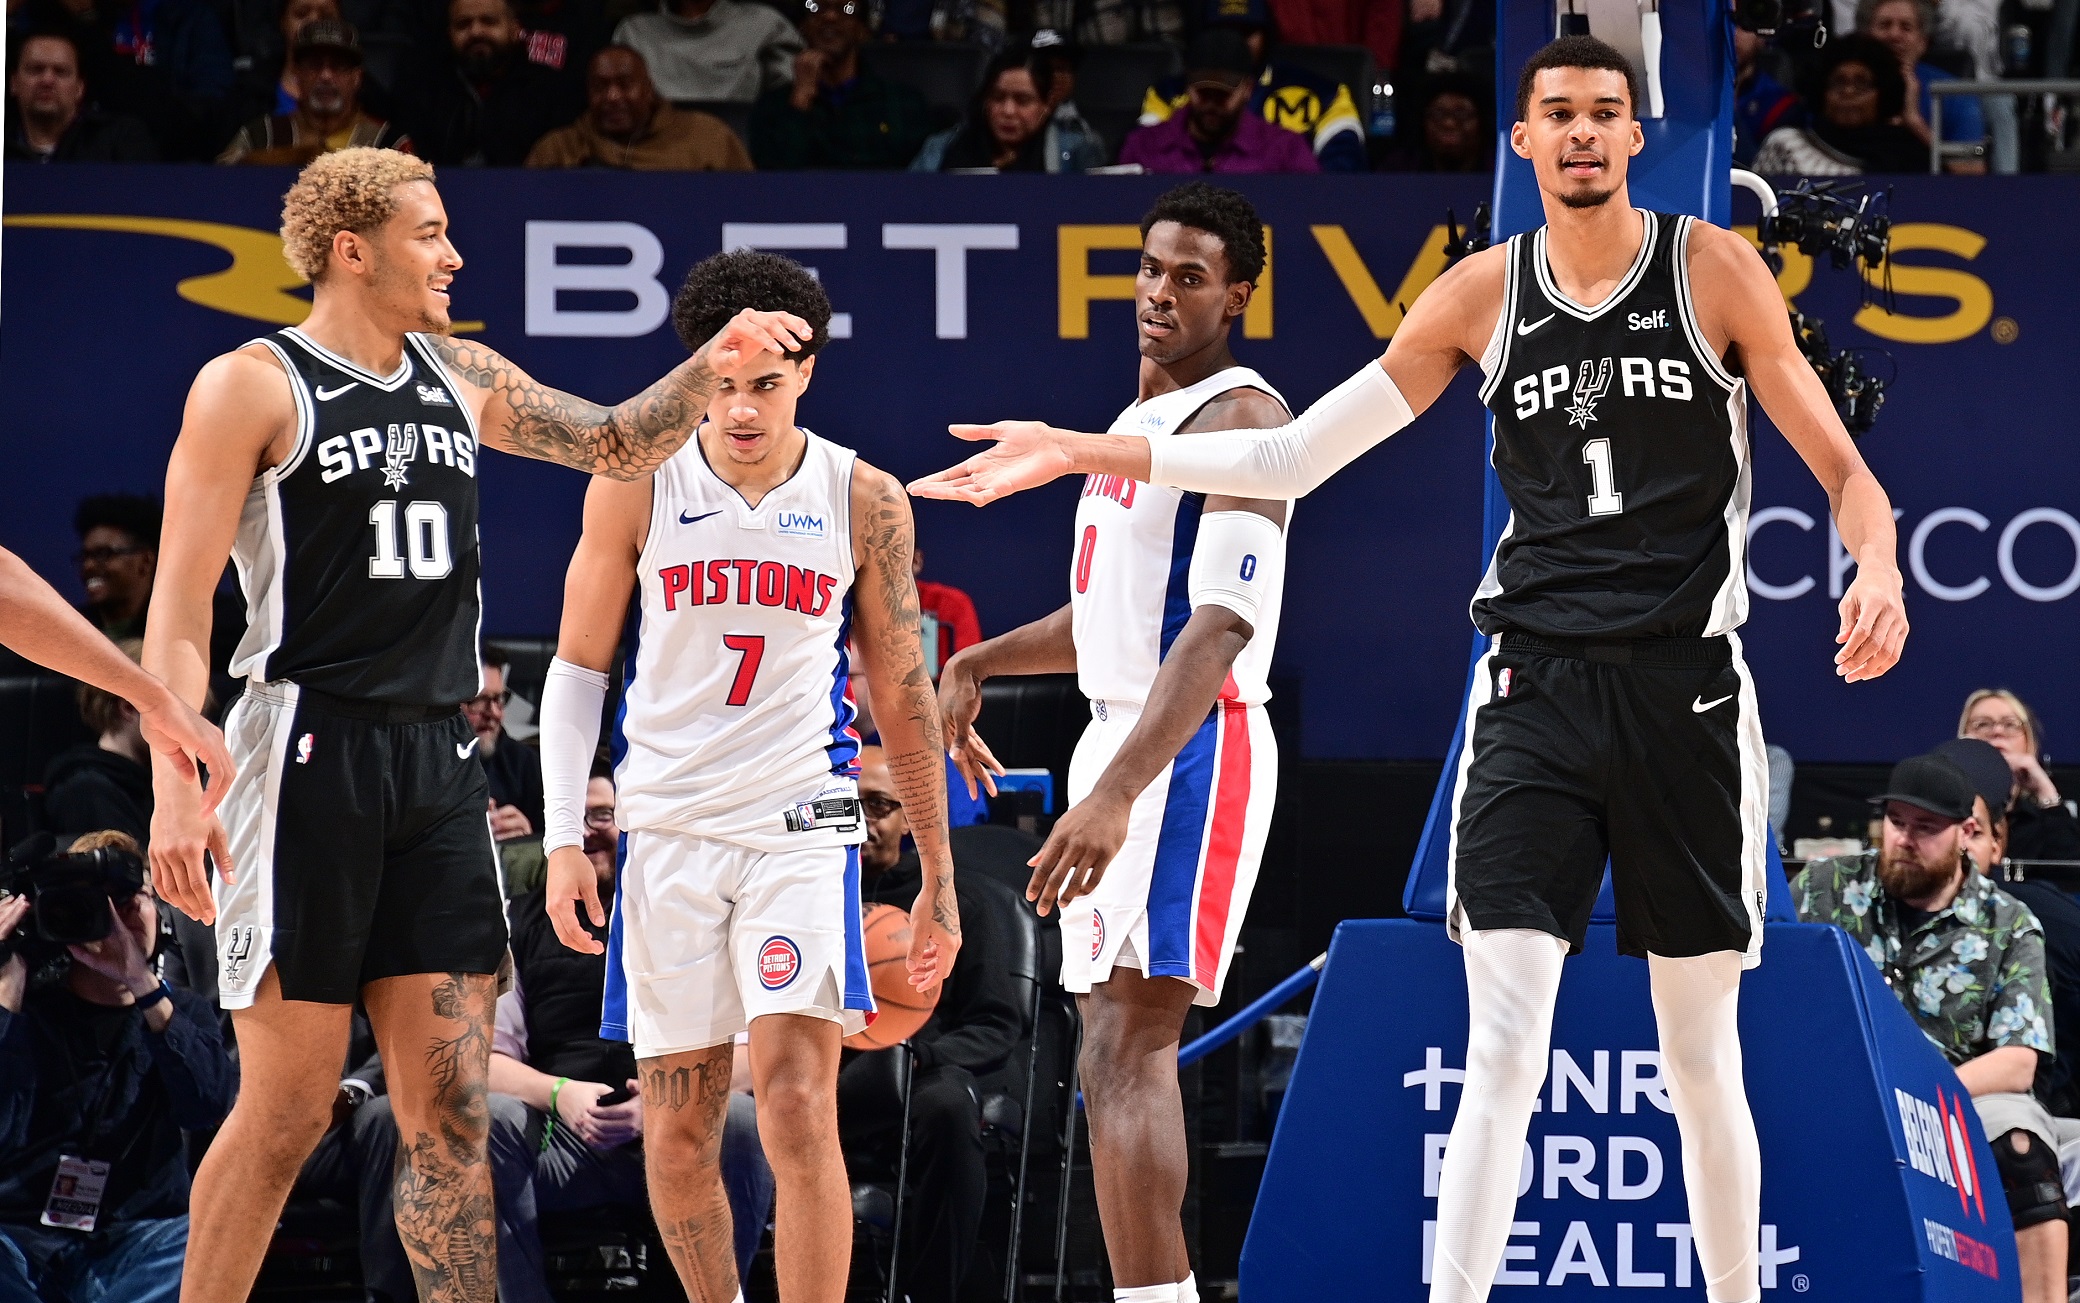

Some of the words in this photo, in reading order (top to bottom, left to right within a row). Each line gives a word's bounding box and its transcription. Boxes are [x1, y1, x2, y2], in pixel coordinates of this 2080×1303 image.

[1582, 437, 1623, 517] 1
[368, 499, 453, 579] 10
[779, 512, 823, 531] UWM
[658, 559, 838, 617] PISTONS
[1076, 525, 1097, 594] 0
[1239, 554, 1257, 581] 0
[723, 634, 765, 706] 7
[763, 953, 791, 965] DETROIT
[763, 962, 791, 974] PISTONS
[1423, 1133, 1664, 1201] FRD
[1894, 1087, 1958, 1188] BELFOR
